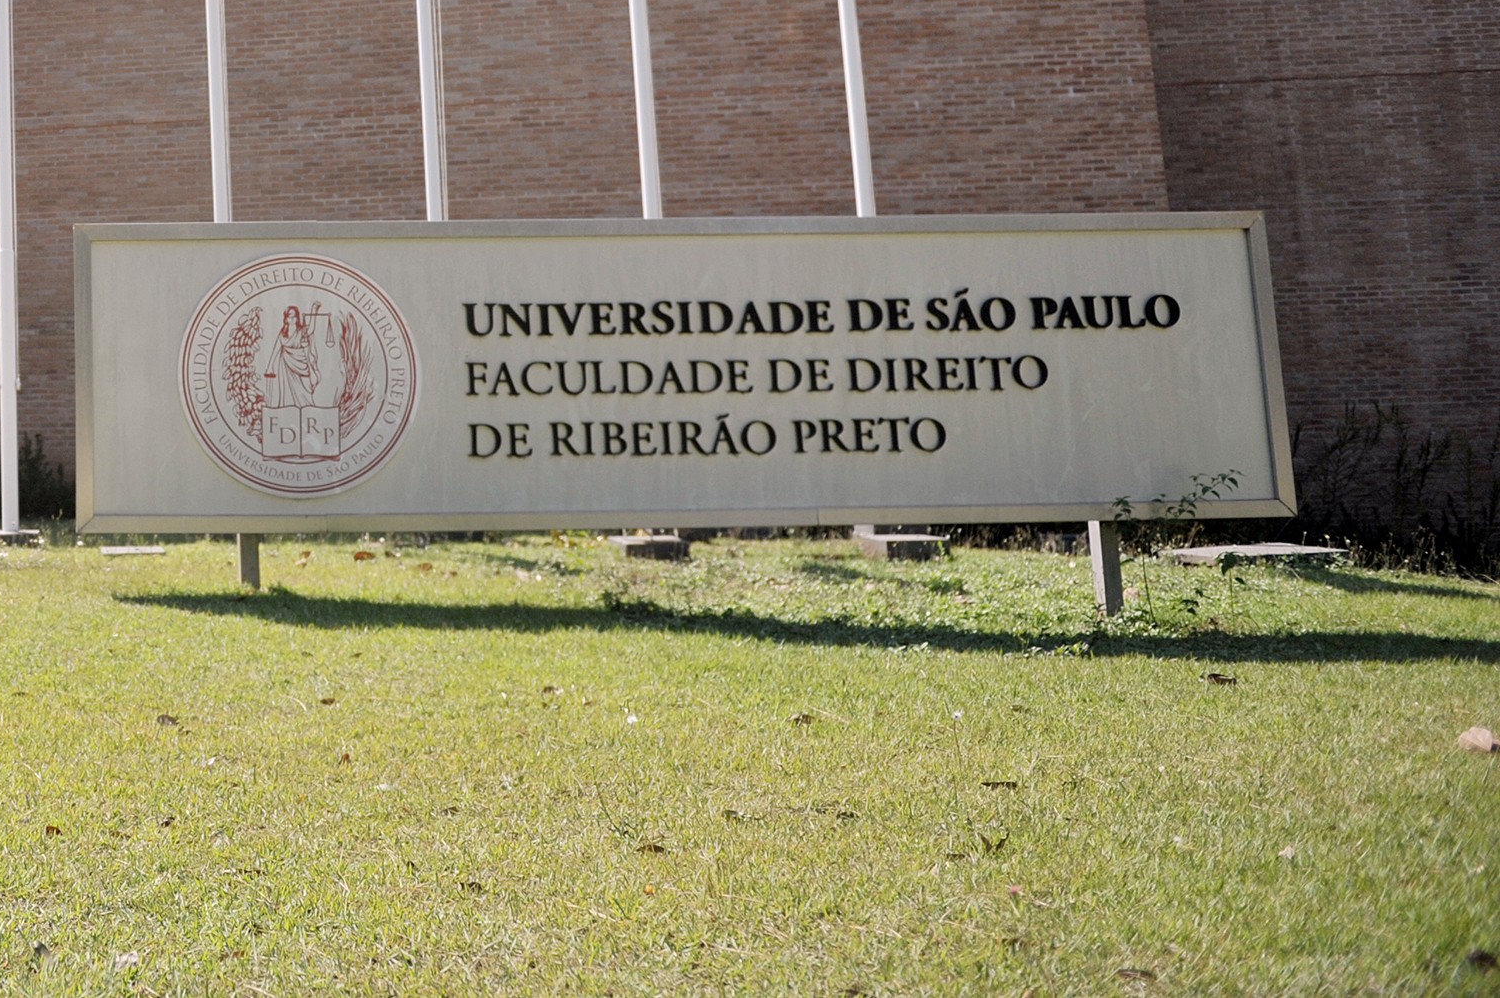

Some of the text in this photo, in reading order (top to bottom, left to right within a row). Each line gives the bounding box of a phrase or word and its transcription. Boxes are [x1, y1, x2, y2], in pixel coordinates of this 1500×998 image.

[462, 288, 1181, 336] UNIVERSIDADE DE SÃO PAULO
[194, 268, 405, 426] FACULDADE DE DIREITO DE RIBEIRÃO PRETO
[465, 355, 1049, 396] FACULDADE DE DIREITO
[219, 434, 301, 481] UNIVERSIDADE
[307, 472, 323, 481] DE
[352, 434, 385, 466] PAULO
[467, 413, 947, 457] DE RIBEIRÃO PRETO
